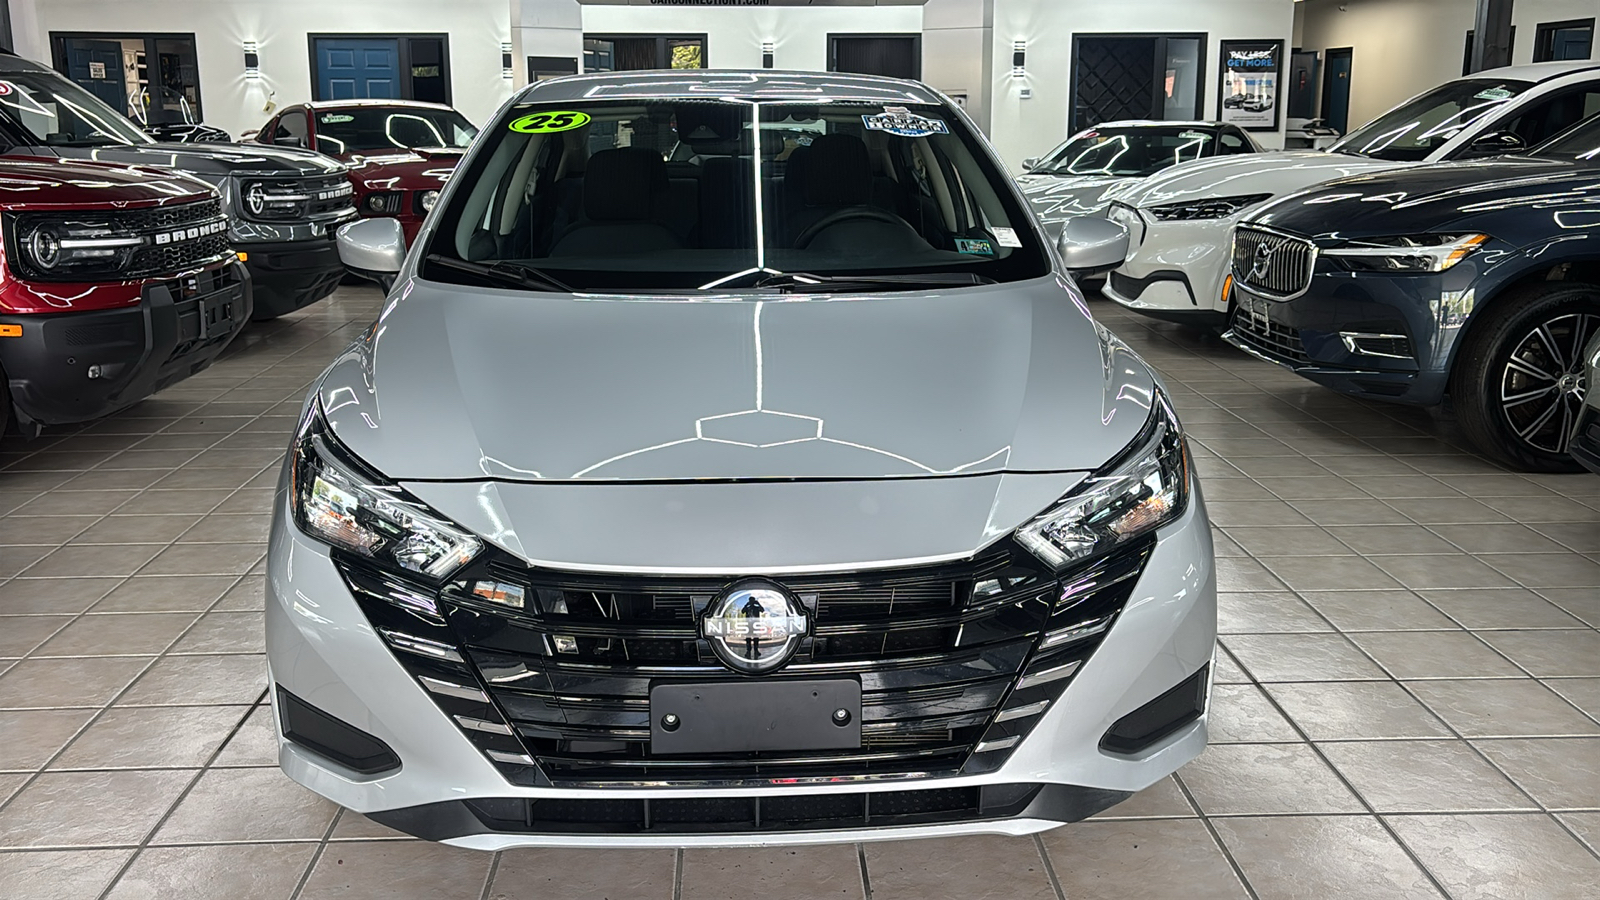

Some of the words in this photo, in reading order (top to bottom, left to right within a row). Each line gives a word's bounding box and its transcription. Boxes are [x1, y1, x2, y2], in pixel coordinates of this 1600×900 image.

[1227, 59, 1244, 67] GET
[1246, 59, 1275, 67] MORE.
[523, 113, 578, 130] 25
[319, 186, 354, 200] BRONCO
[155, 220, 228, 245] BRONCO
[707, 618, 804, 634] NISSAN
